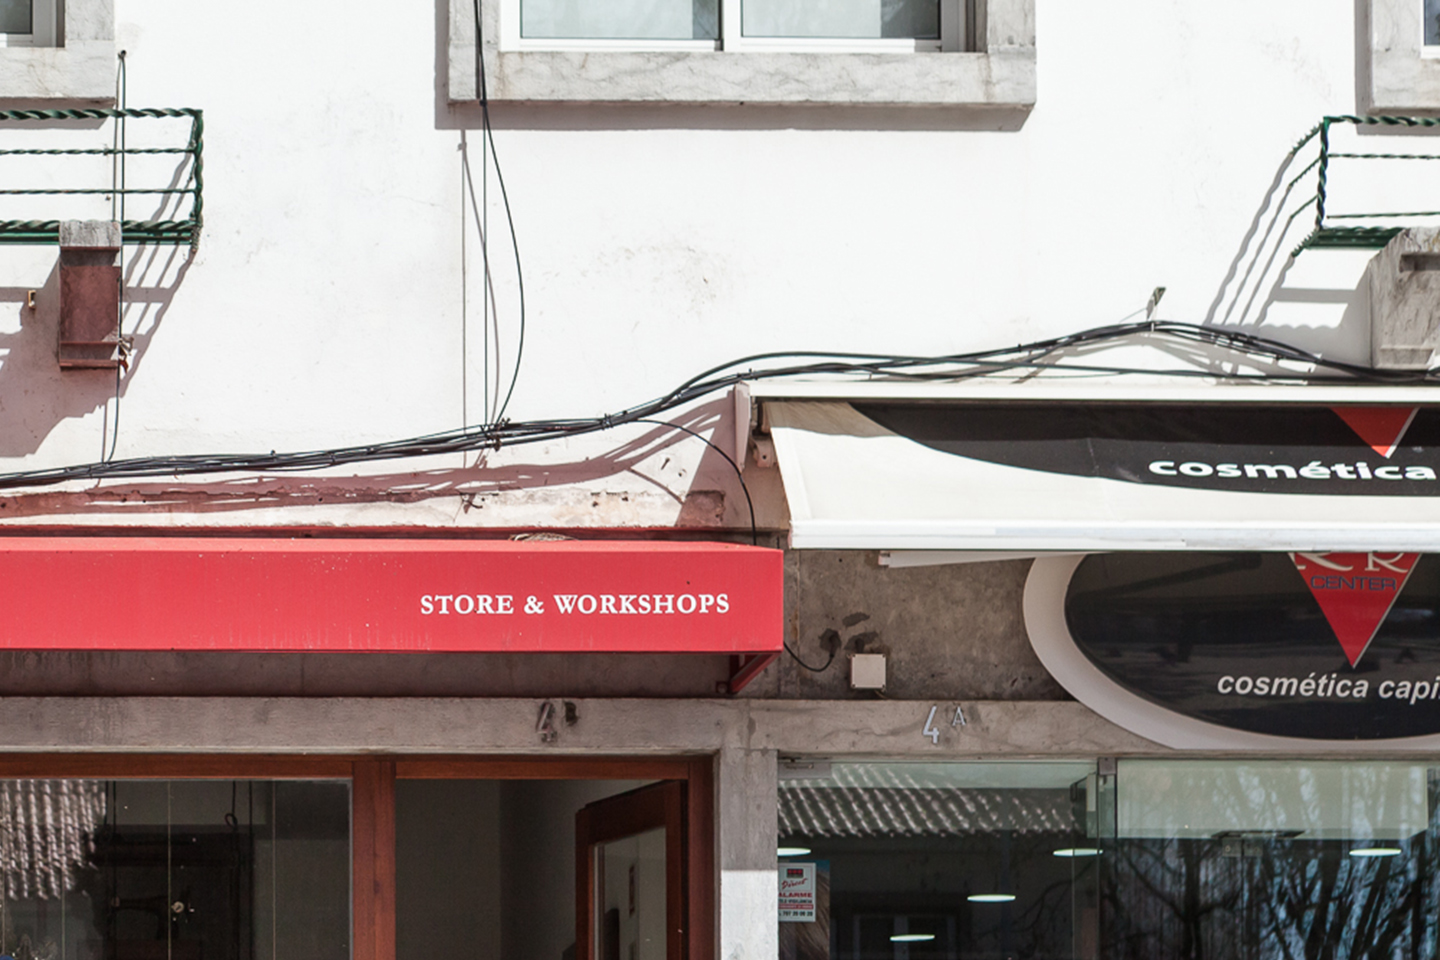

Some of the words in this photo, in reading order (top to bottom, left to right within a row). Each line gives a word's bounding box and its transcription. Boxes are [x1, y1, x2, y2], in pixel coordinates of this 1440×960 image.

[1148, 461, 1437, 480] cosmética
[1310, 575, 1397, 591] CENTER
[420, 594, 514, 615] STORE
[523, 594, 545, 615] &
[553, 593, 730, 615] WORKSHOPS
[1217, 672, 1370, 698] cosmética
[1378, 676, 1440, 705] capi
